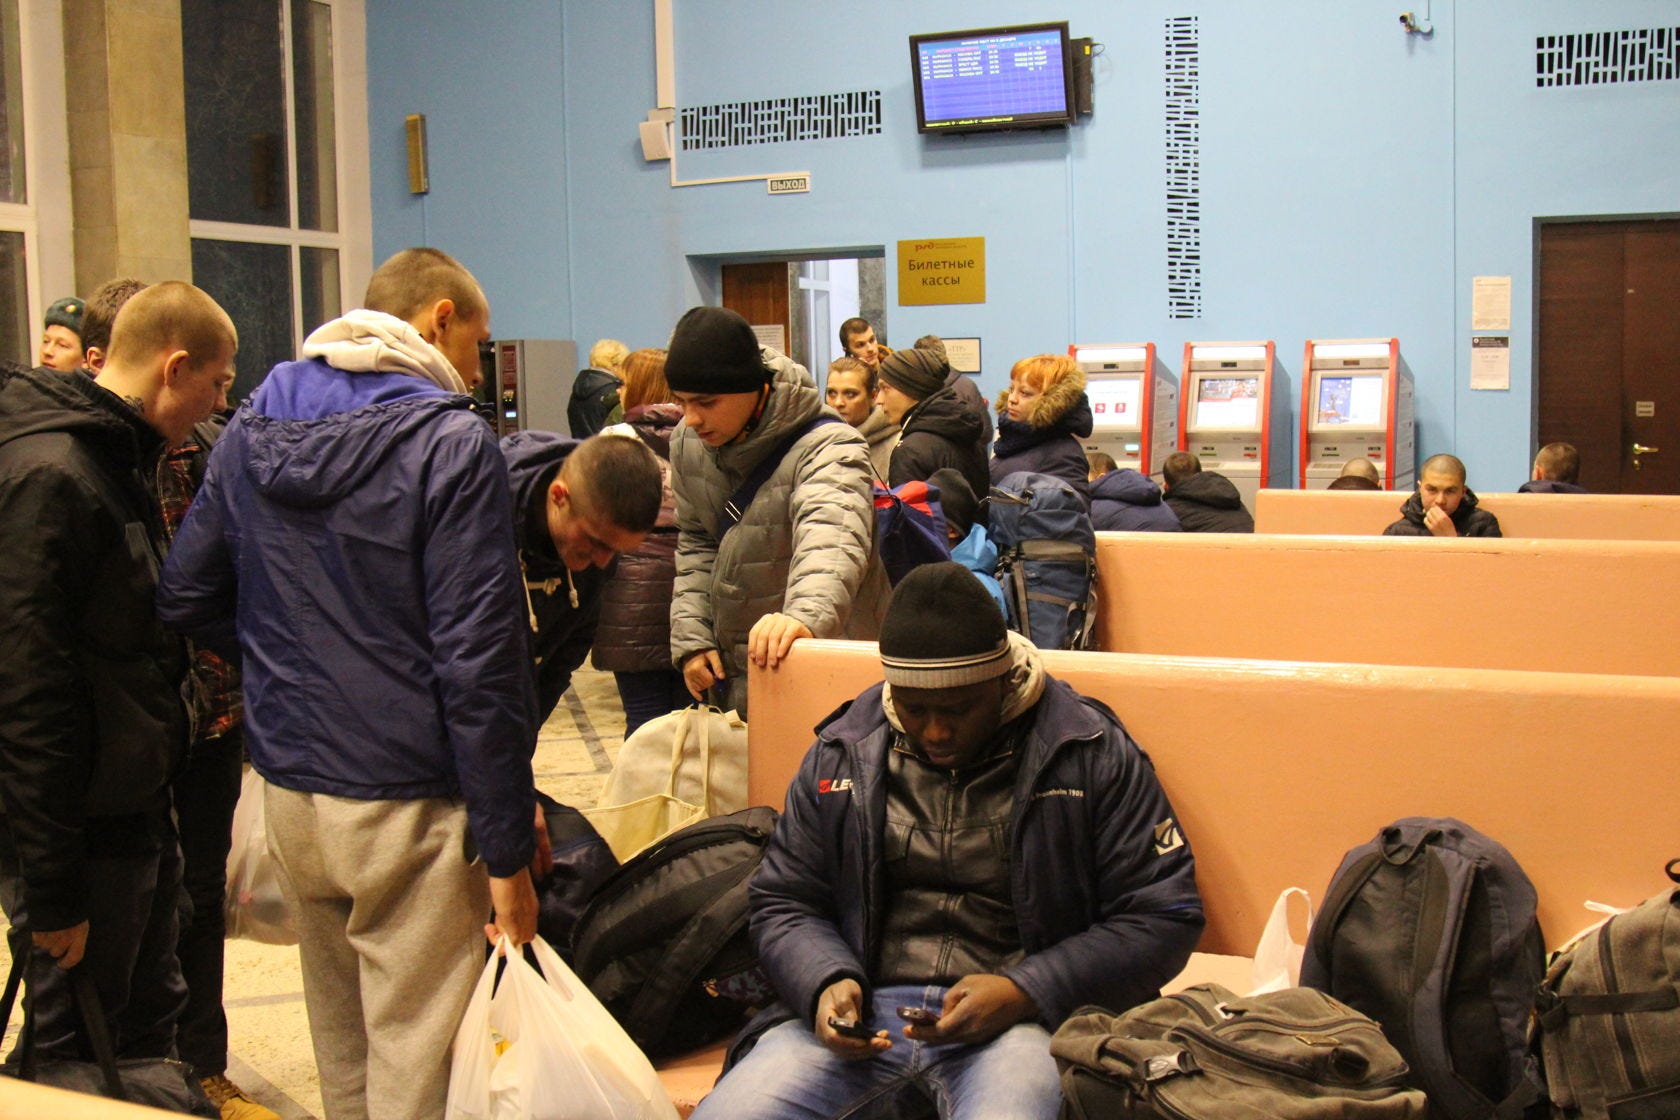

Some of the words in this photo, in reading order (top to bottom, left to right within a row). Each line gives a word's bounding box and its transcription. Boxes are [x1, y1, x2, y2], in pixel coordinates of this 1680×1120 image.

[773, 178, 804, 190] ВЫХОД
[908, 258, 976, 271] Билетные
[921, 275, 961, 286] кассы
